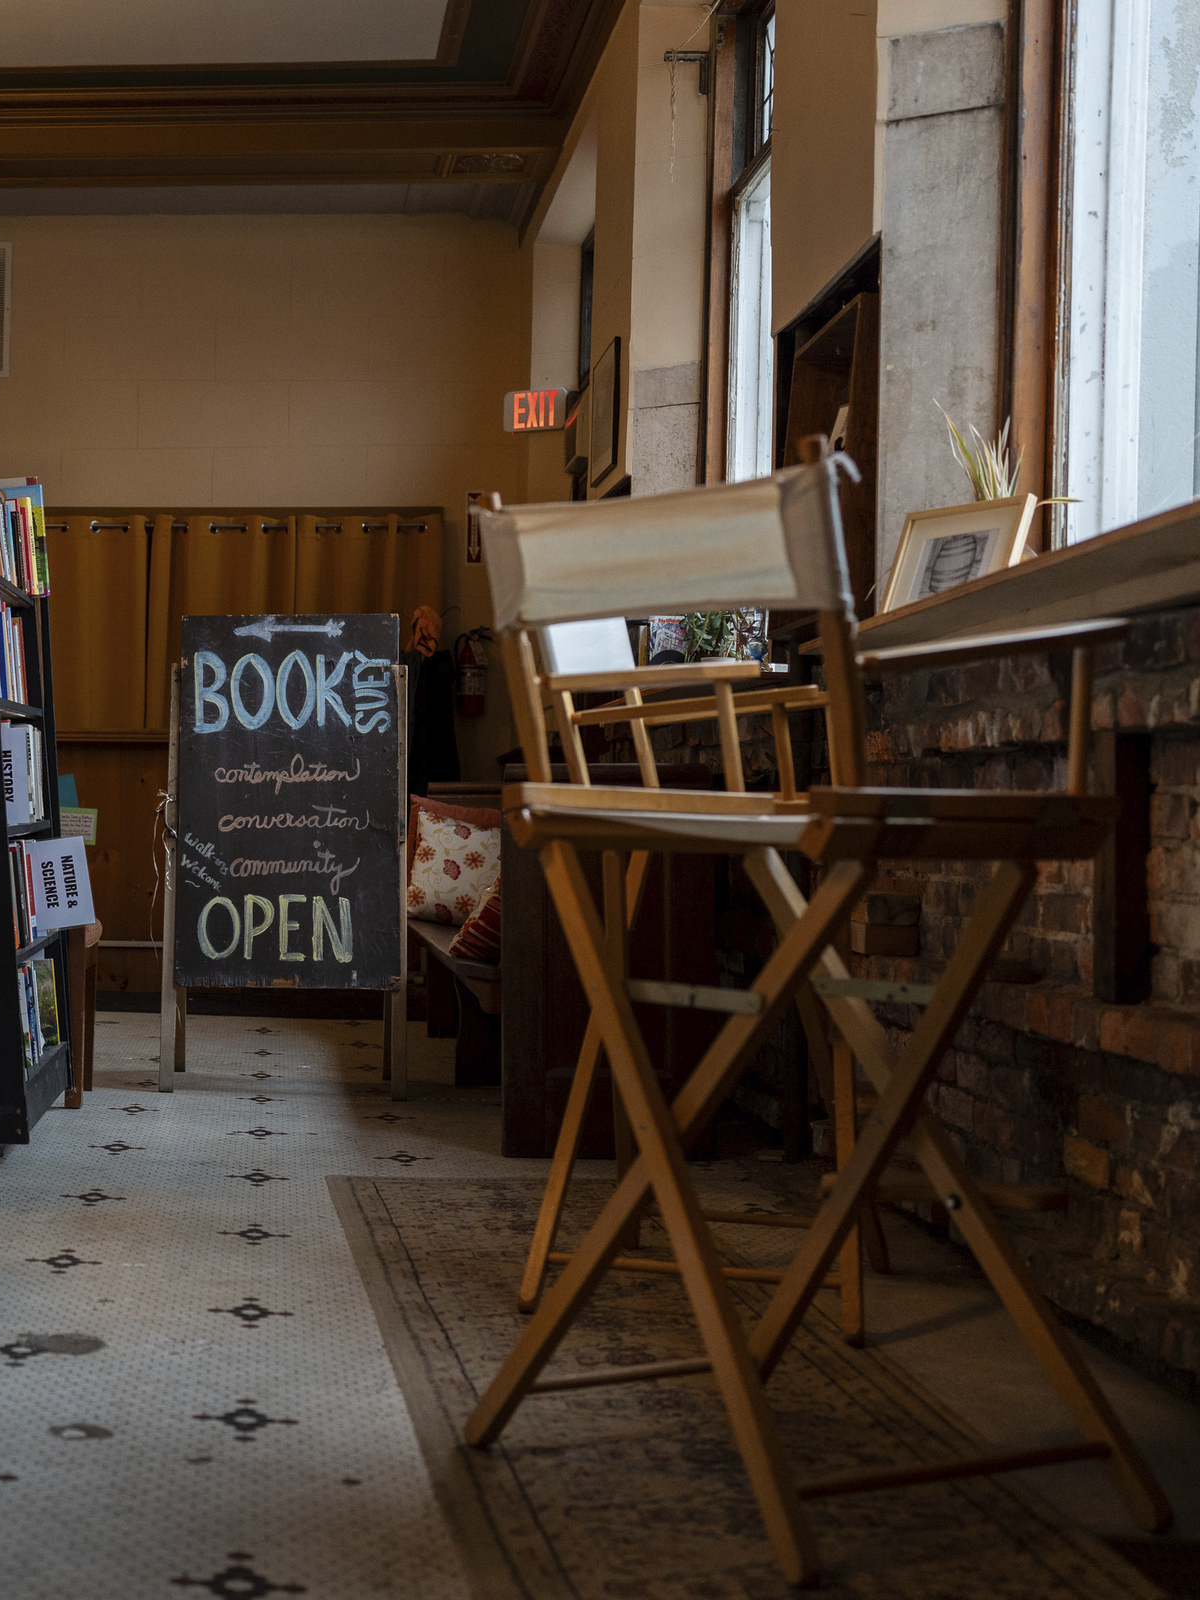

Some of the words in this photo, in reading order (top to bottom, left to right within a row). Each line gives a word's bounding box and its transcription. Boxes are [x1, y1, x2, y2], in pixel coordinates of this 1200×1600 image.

[513, 390, 558, 429] EXIT
[193, 650, 353, 734] BOOK
[352, 650, 391, 734] SUEY
[2, 750, 14, 803] HISTORY
[214, 754, 360, 795] contemplation
[218, 800, 370, 832] conversation
[41, 861, 59, 909] SCIENCE
[61, 855, 78, 898] NATURE
[230, 841, 360, 895] community
[67, 900, 78, 909] &
[197, 893, 354, 963] OPEN
